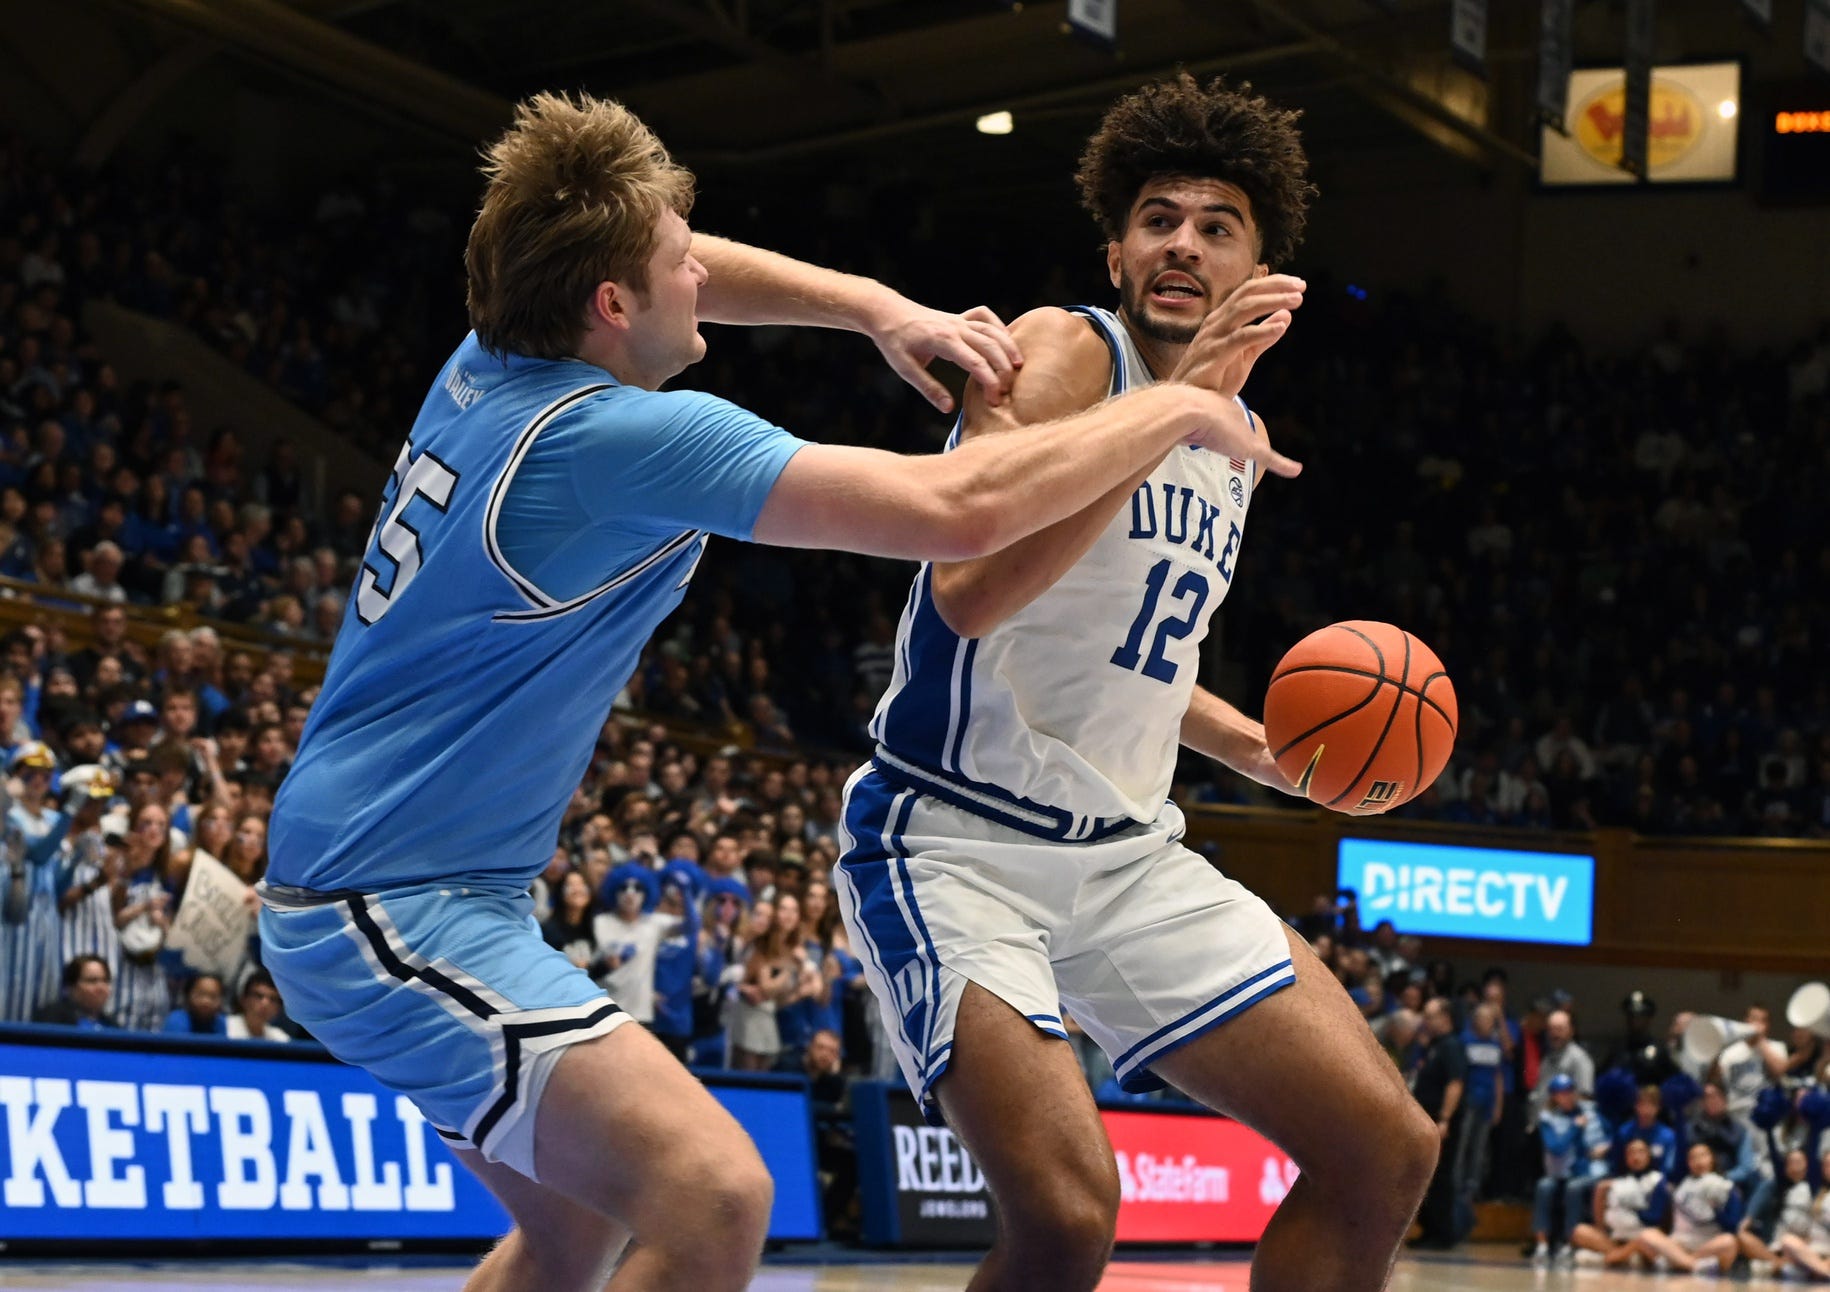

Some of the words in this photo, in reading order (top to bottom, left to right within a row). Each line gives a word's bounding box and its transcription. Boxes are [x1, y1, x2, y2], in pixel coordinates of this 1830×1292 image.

[1129, 480, 1241, 584] DUKE
[1110, 558, 1209, 684] 12
[1363, 861, 1568, 921] DIRECTV
